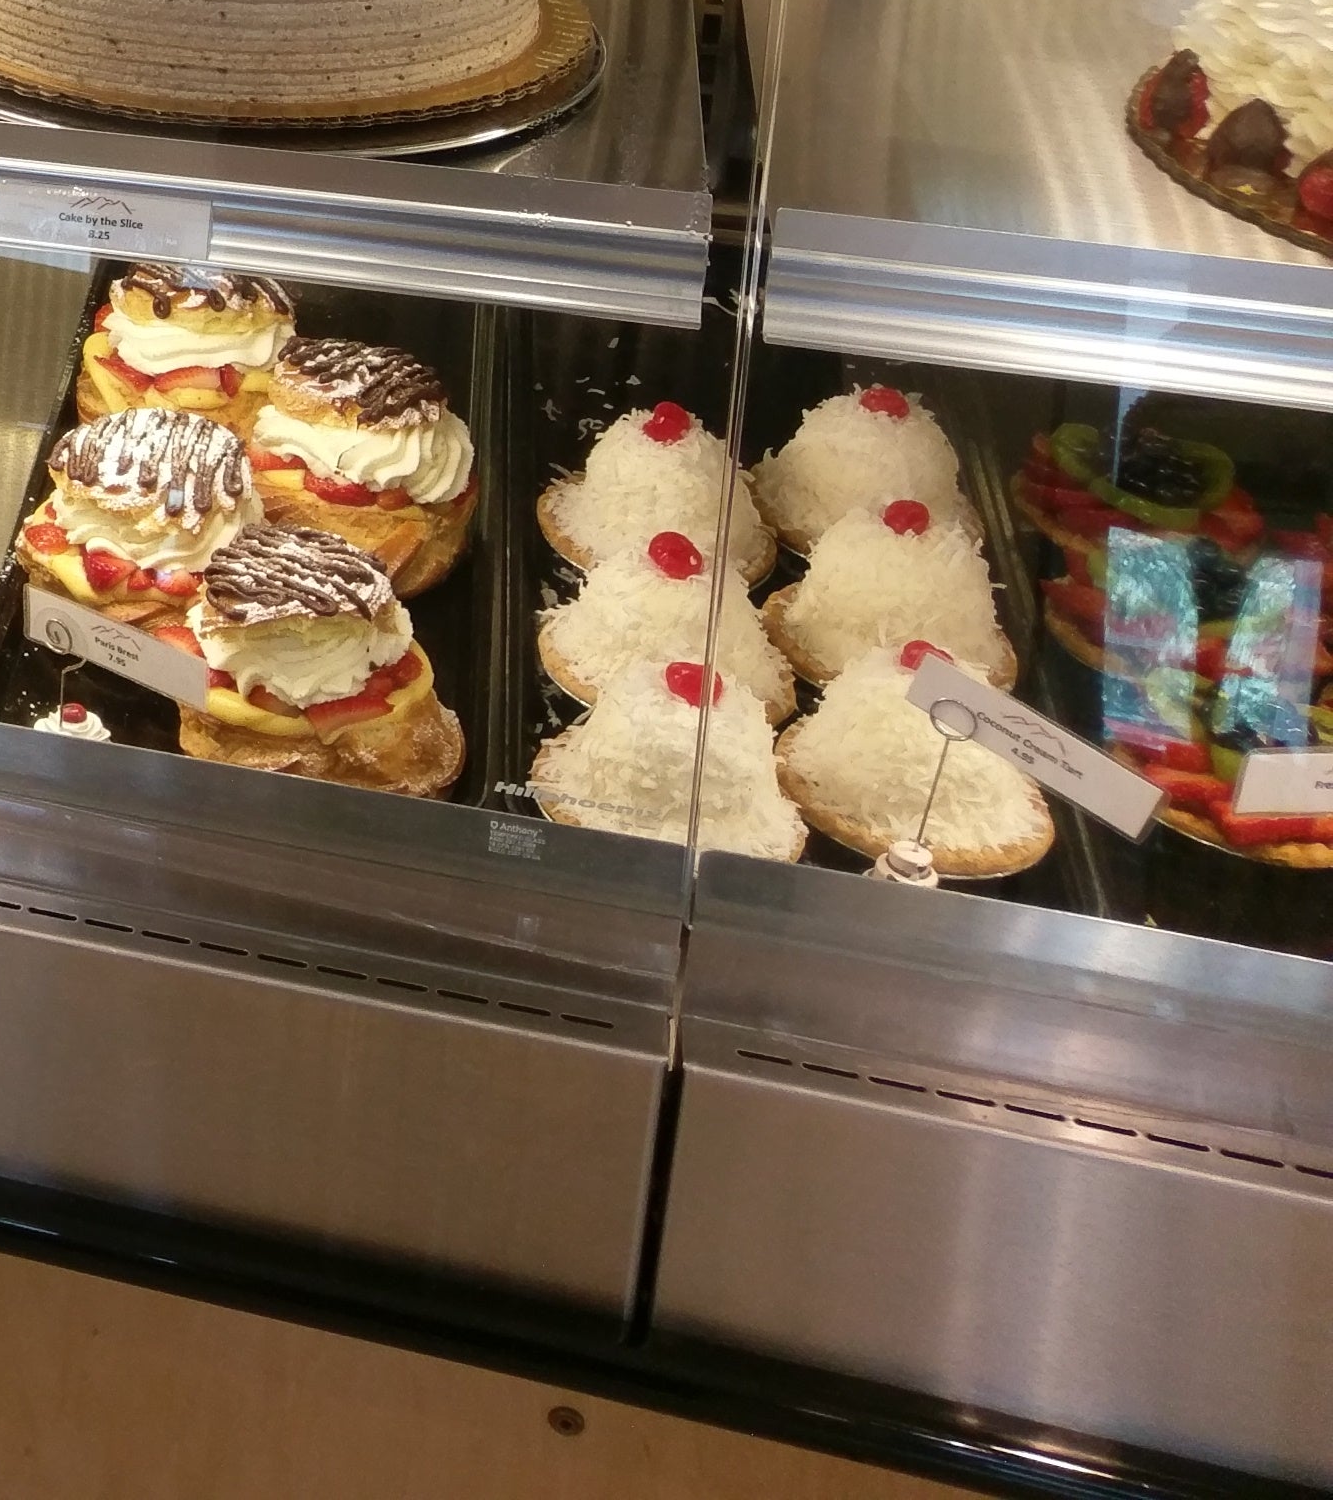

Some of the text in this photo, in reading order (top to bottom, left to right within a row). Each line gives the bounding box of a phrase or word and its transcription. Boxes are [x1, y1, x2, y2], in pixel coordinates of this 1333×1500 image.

[58, 212, 144, 230] Cake by the Slice
[88, 230, 110, 240] 8.25
[94, 636, 139, 662] Paris Brest
[108, 653, 126, 667] 7.95
[977, 711, 1083, 780] Coconut Cream Tart
[500, 822, 538, 838] Anthony
